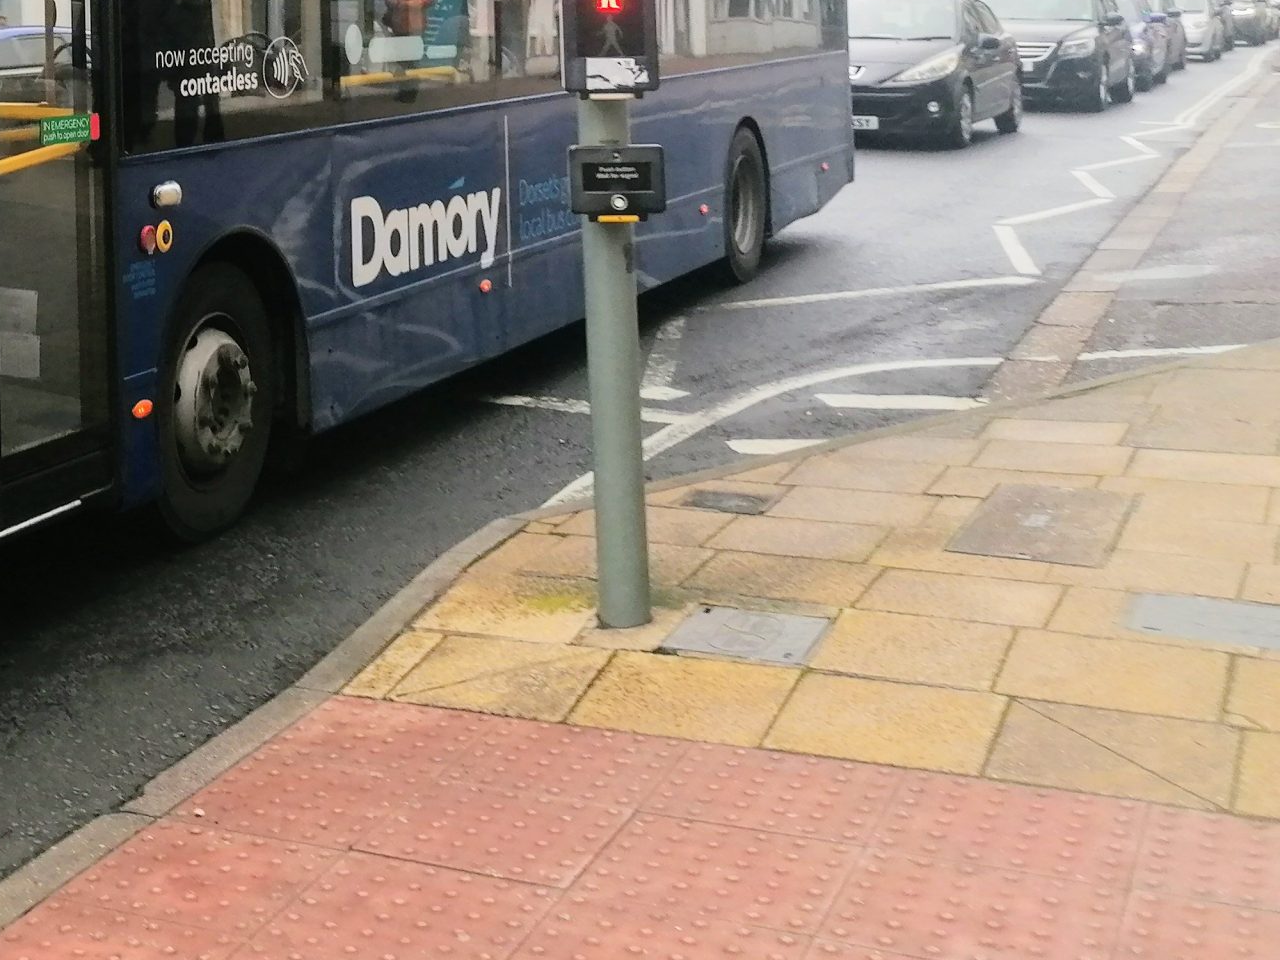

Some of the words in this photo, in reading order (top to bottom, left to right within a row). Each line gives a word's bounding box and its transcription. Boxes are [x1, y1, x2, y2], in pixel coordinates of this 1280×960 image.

[155, 49, 186, 69] now
[189, 40, 254, 71] accepting
[180, 66, 259, 97] contactless
[51, 117, 90, 131] EMERGENCY
[43, 131, 57, 145] push
[57, 130, 63, 140] to
[63, 131, 77, 142] open
[77, 128, 90, 138] door
